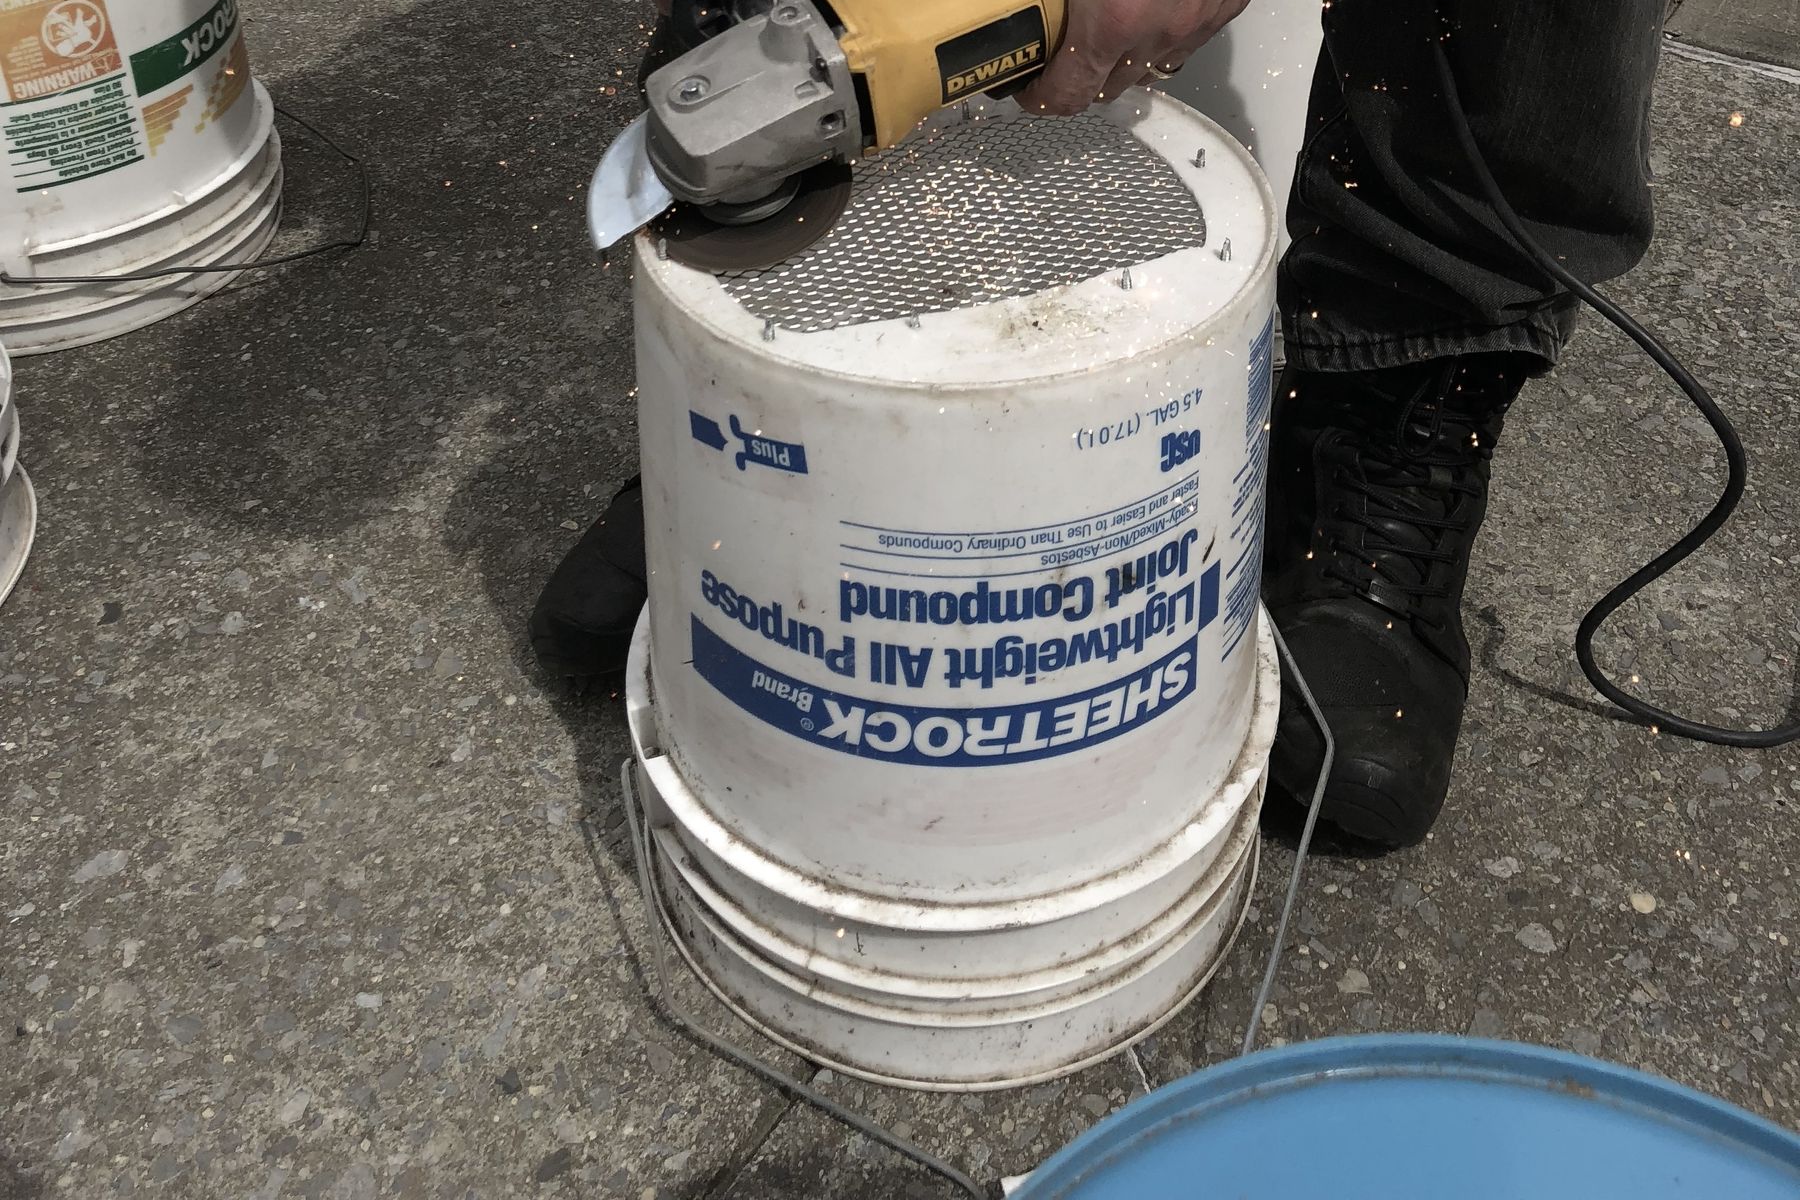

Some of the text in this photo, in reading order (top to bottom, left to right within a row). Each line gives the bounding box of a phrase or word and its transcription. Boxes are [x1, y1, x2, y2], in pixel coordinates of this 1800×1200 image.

[12, 62, 98, 99] WARNING
[1146, 400, 1180, 426] GAL.
[1183, 388, 1203, 412] 4.5
[1099, 412, 1141, 445] (17.0
[751, 439, 791, 467] Plus
[1160, 429, 1201, 473] USG
[878, 476, 1200, 553] Faster and Easier to Use Than Ordinary Compounds
[838, 528, 1199, 626] Joint Compound
[701, 569, 1196, 689] Lightweight All Purpose
[752, 670, 814, 713] Brand
